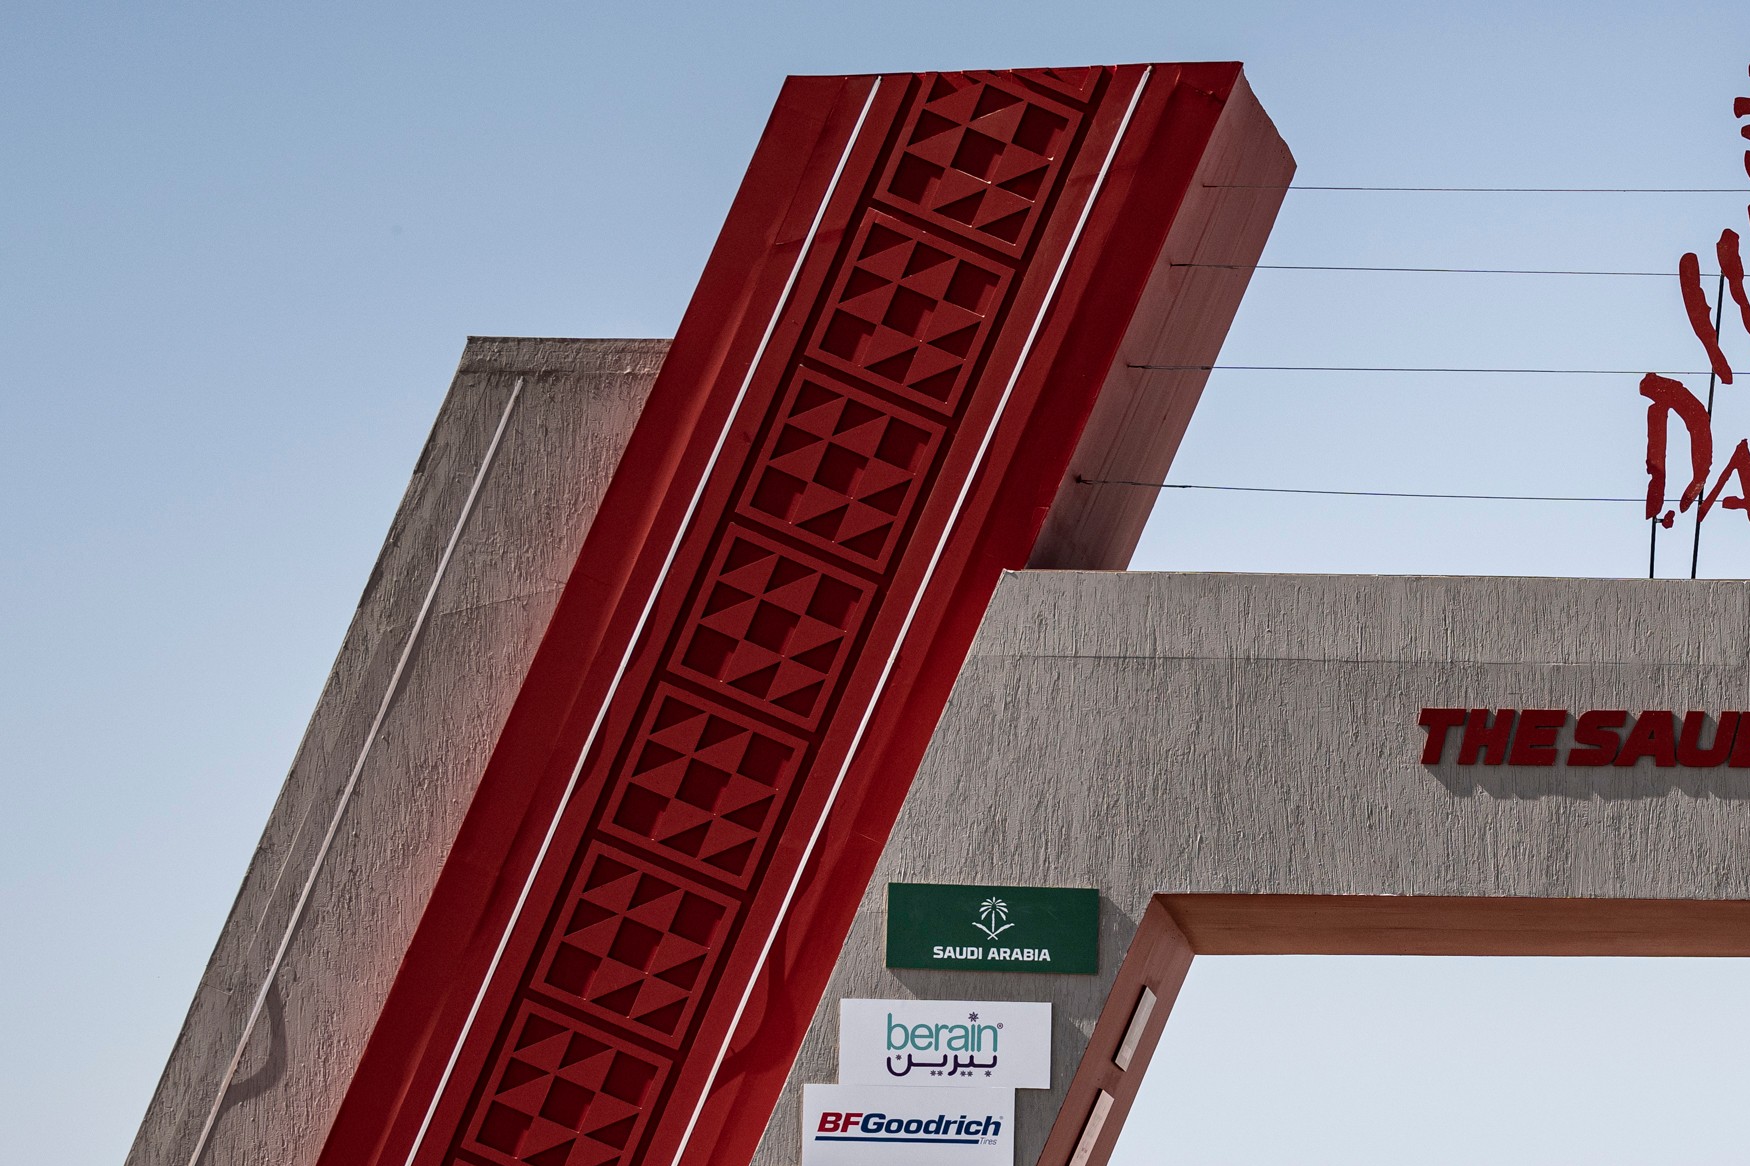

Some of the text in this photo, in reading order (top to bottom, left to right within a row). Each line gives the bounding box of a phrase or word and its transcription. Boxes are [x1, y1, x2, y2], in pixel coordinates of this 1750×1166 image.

[1418, 707, 1568, 767] THE
[933, 945, 1051, 962] SAUDI ARABIA
[886, 1011, 998, 1053] berain
[886, 1053, 998, 1078] بيرين
[817, 1111, 1002, 1137] BFGoodrich
[978, 1137, 998, 1146] Tires
